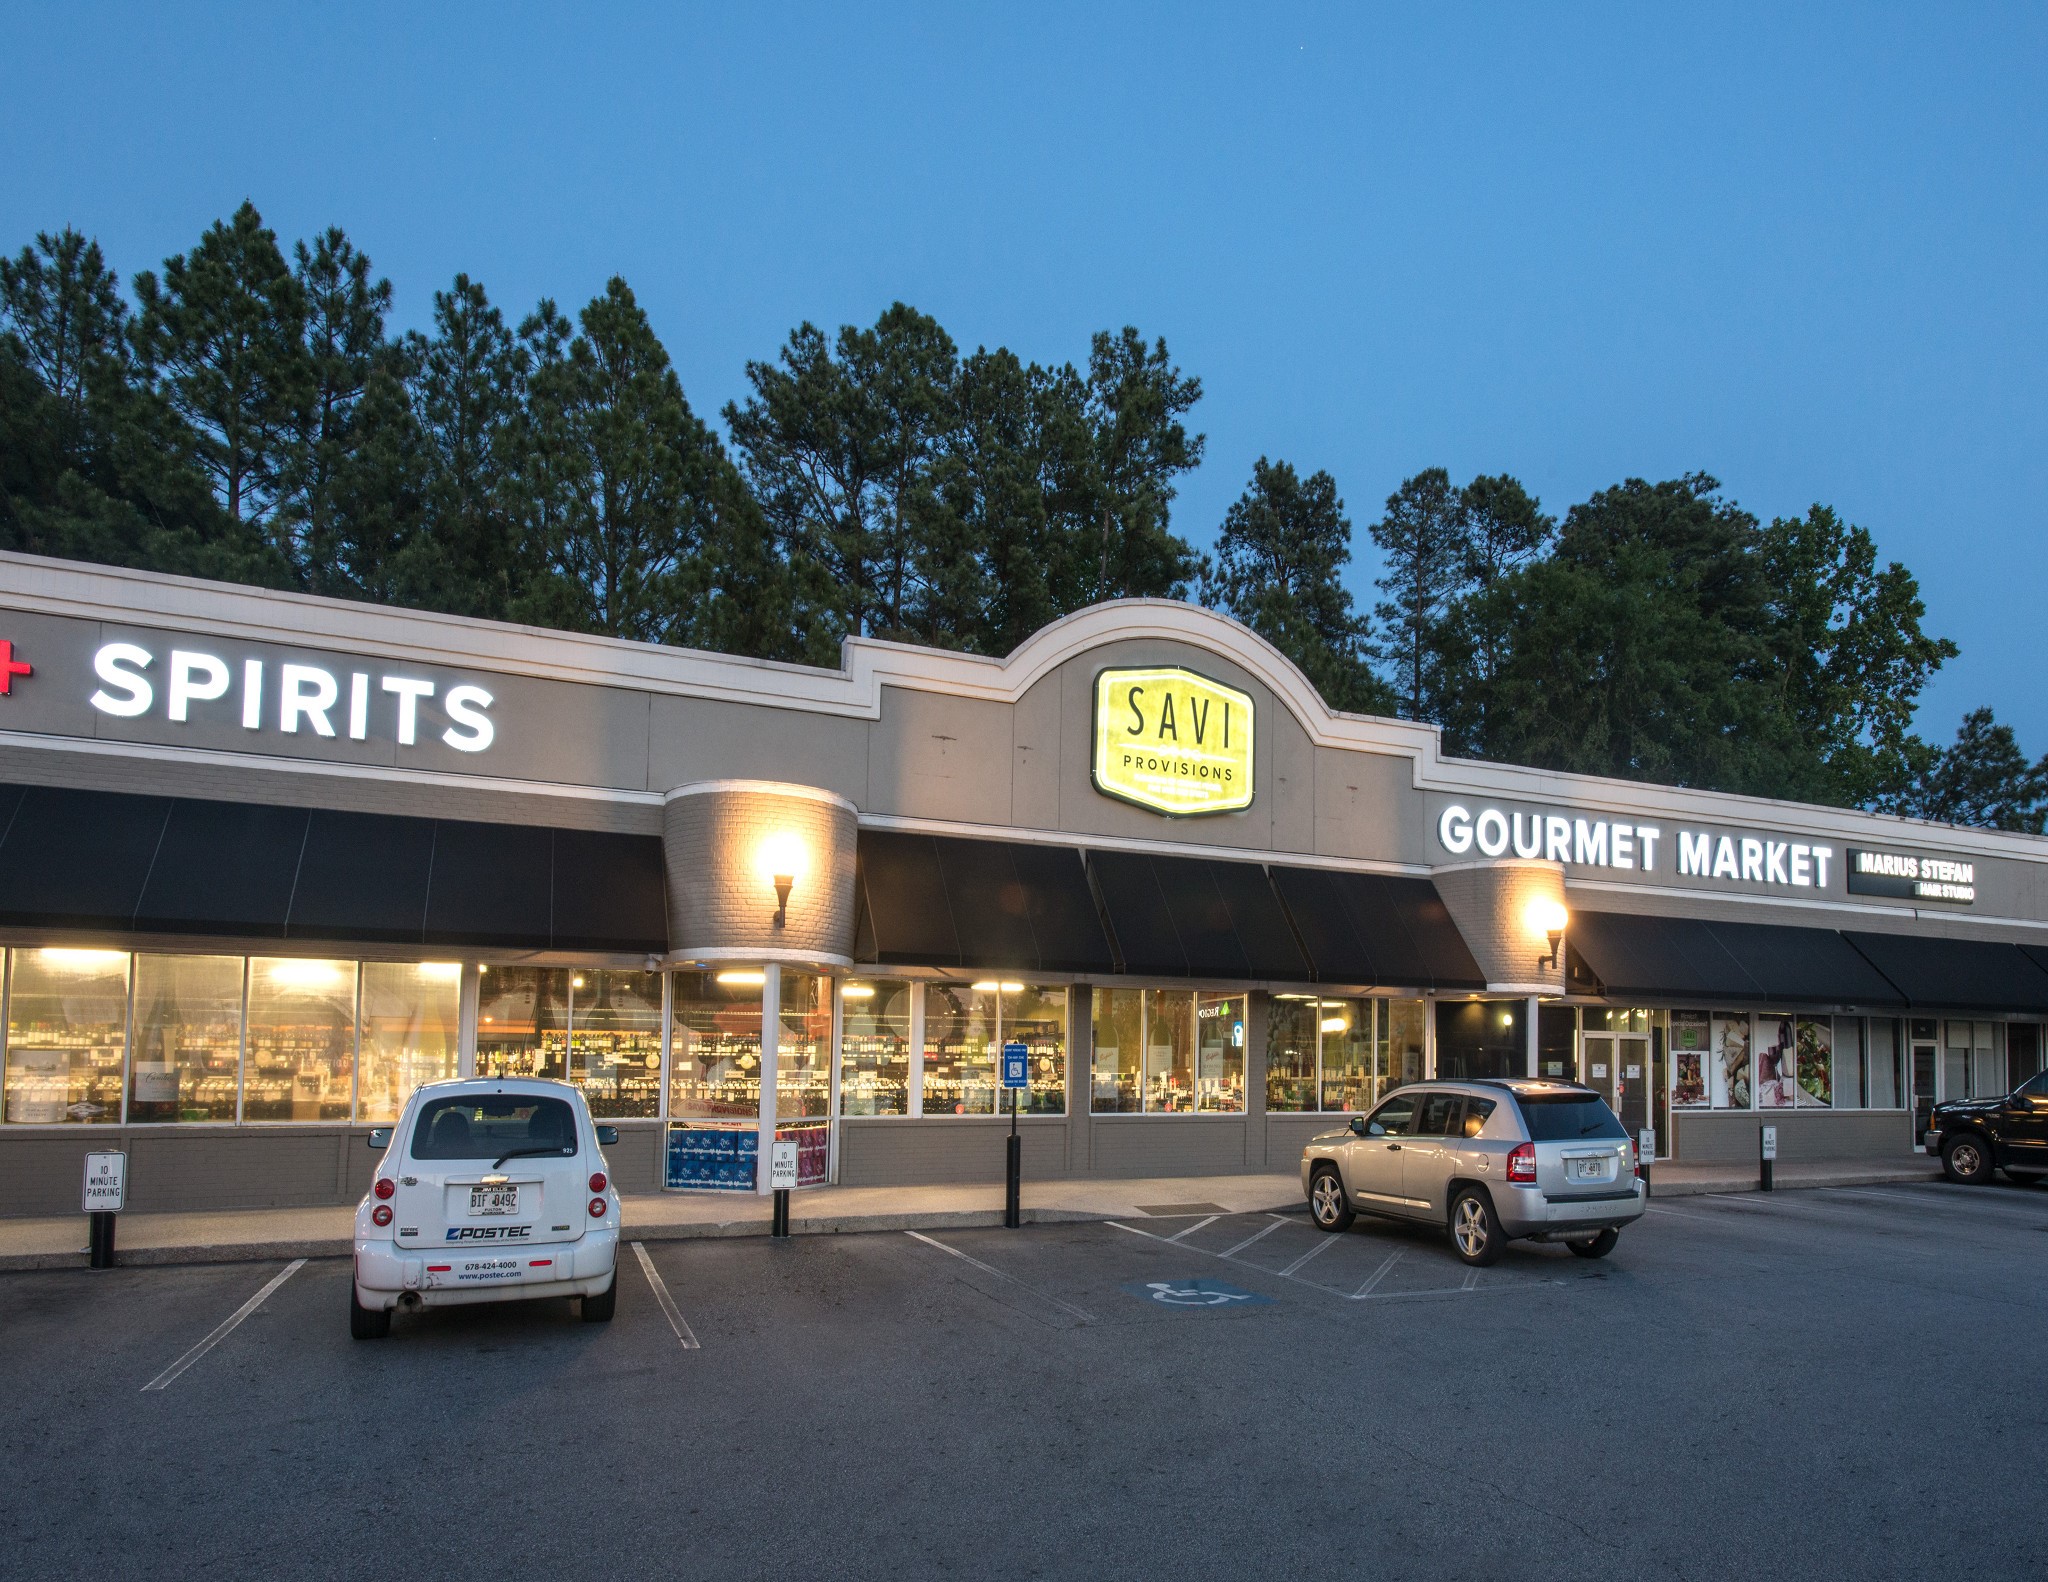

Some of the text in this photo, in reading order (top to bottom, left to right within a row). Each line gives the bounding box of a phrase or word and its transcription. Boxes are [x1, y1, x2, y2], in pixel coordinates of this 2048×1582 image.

[89, 642, 496, 753] SPIRITS
[1127, 686, 1230, 749] SAVI
[1123, 755, 1232, 782] PROVISIONS
[1438, 804, 1833, 888] GOURMET MARKET
[1858, 852, 1973, 883] MARIUS STEFAN
[1919, 882, 1974, 900] HAIR STUDIO
[782, 1151, 788, 1160] 10
[100, 1165, 109, 1175] 10
[774, 1160, 794, 1169] MINUTE
[772, 1169, 795, 1178] PARKING
[89, 1176, 118, 1186] MINUTE
[86, 1187, 120, 1198] PARKING
[471, 1193, 517, 1208] BIF 0492
[459, 1225, 532, 1240] POSTEC
[465, 1261, 517, 1271] 678-424-4000
[458, 1271, 522, 1281] www.postec.com
